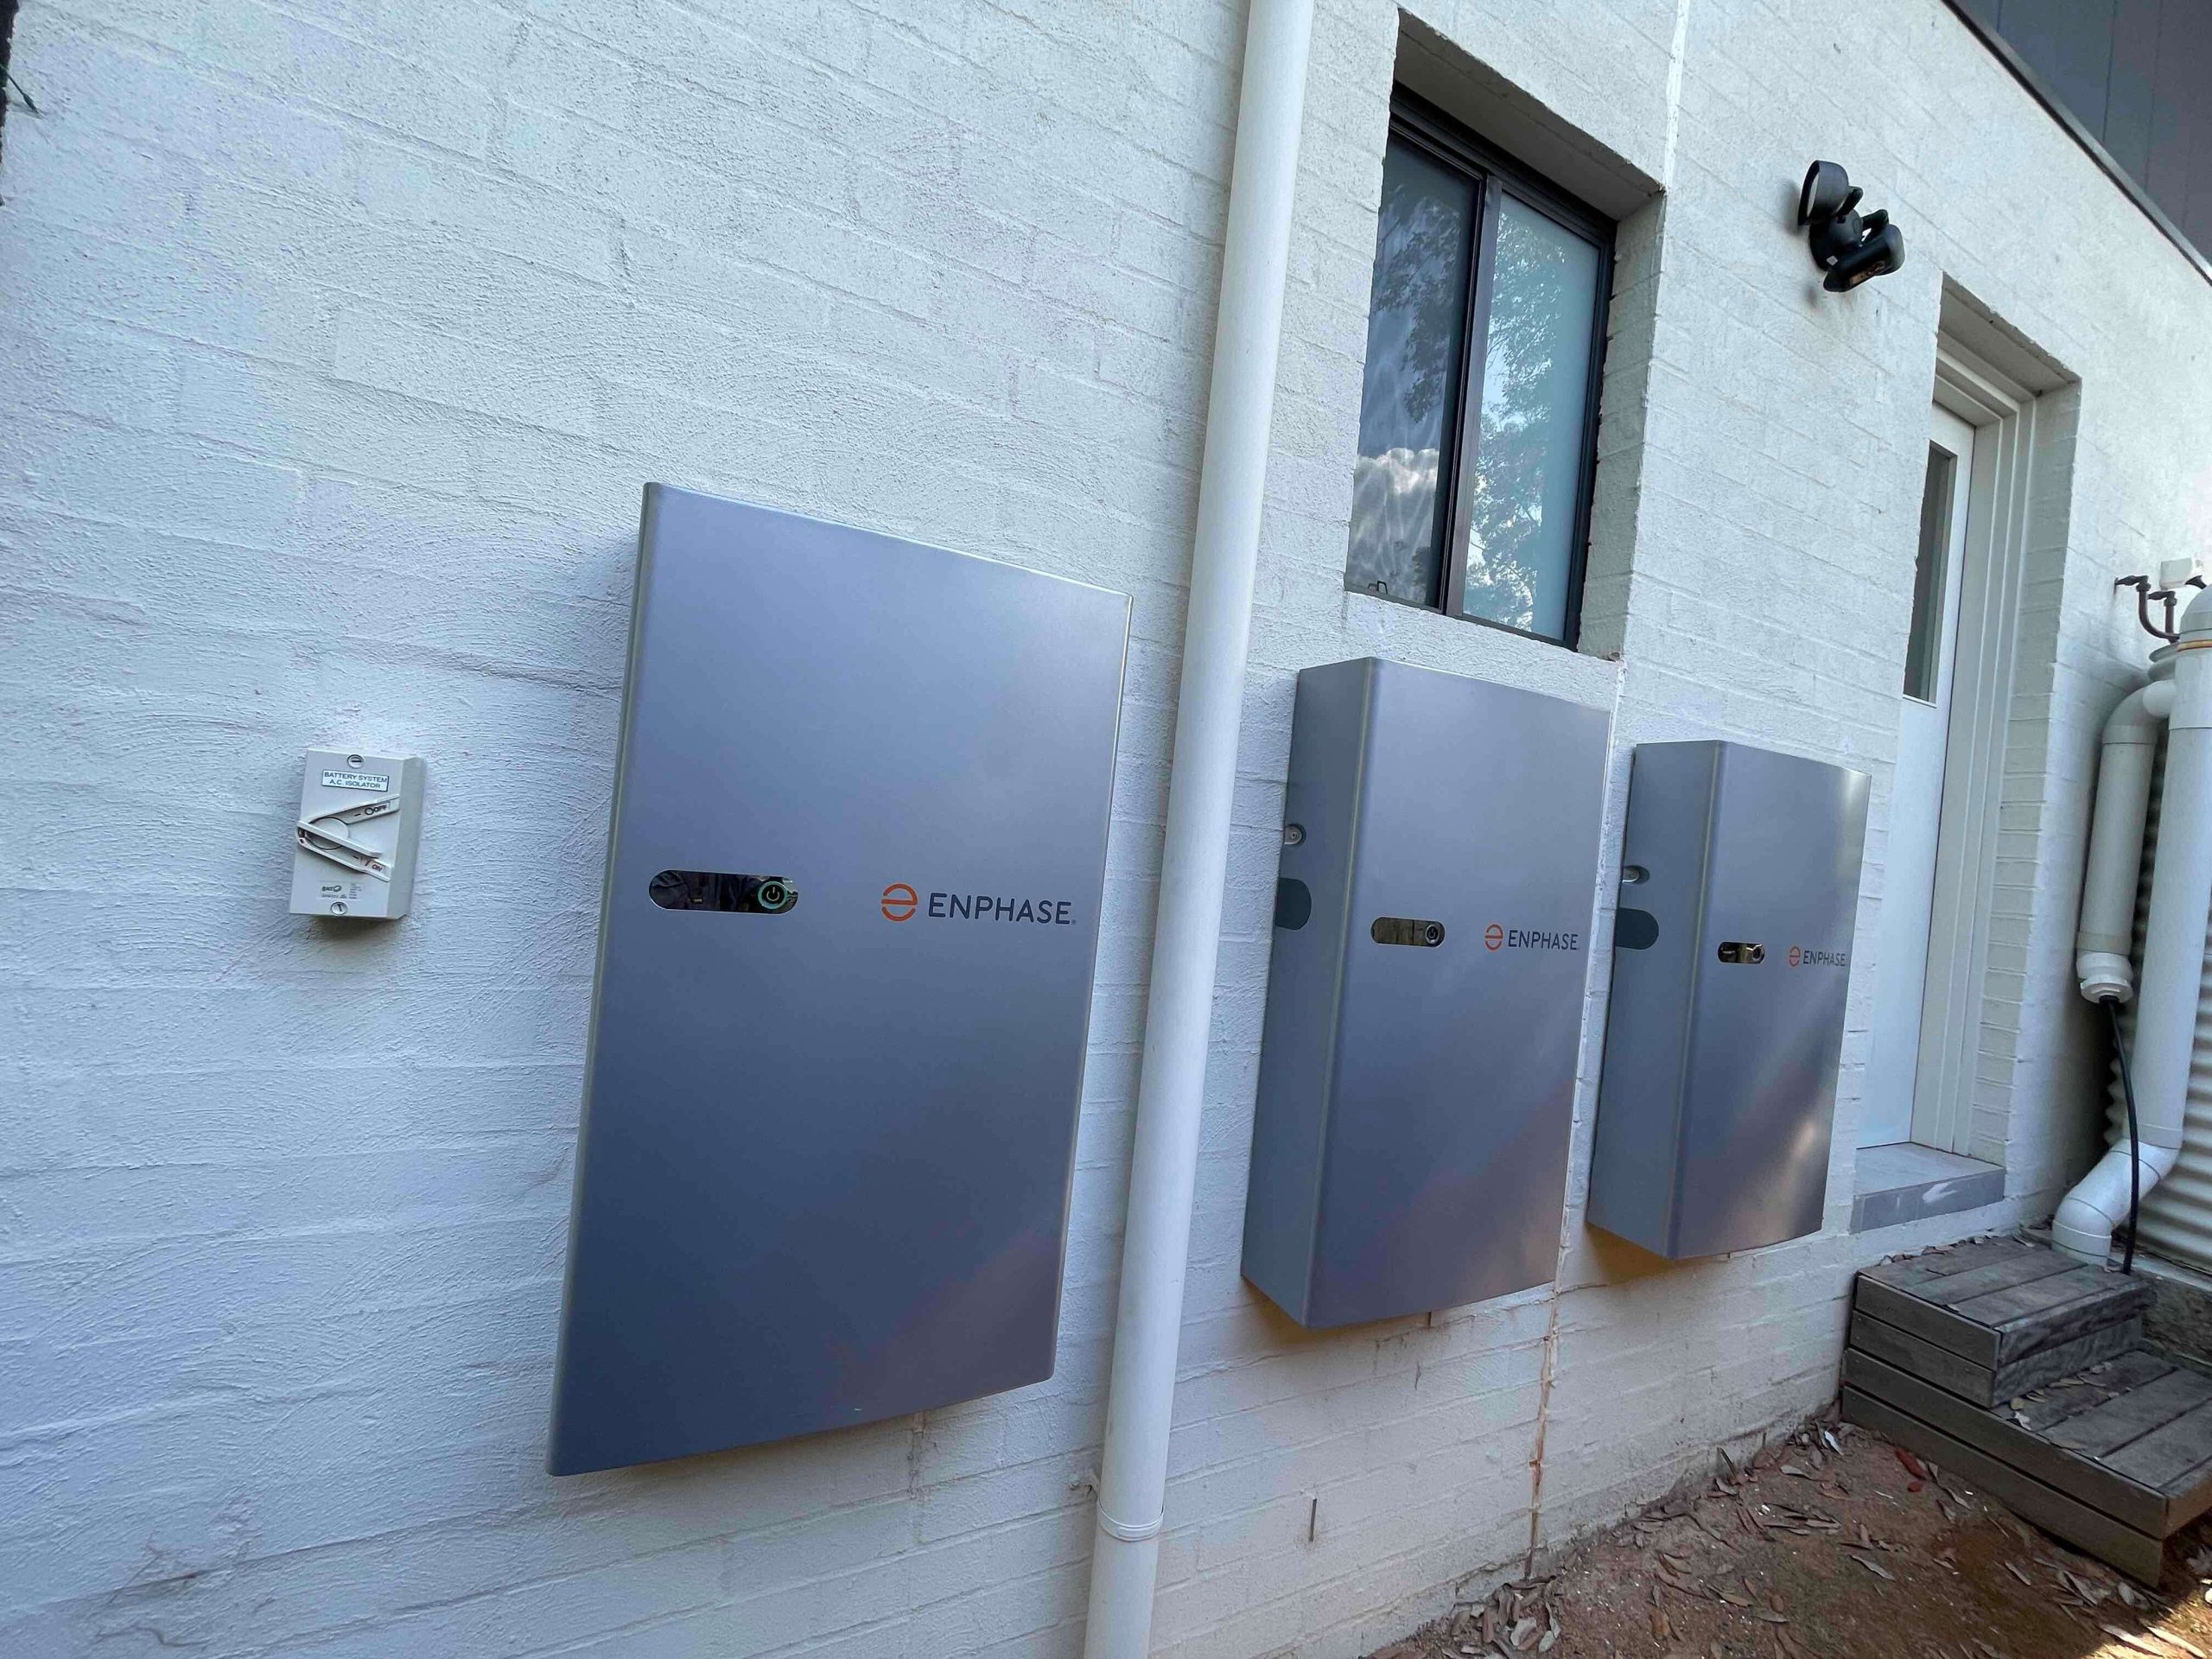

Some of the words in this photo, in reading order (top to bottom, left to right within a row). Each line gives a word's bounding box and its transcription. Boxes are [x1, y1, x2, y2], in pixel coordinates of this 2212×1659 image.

[928, 892, 1072, 925] ENPHASE
[1508, 929, 1580, 950] ENPHASE
[1802, 950, 1847, 967] ENPHASE
